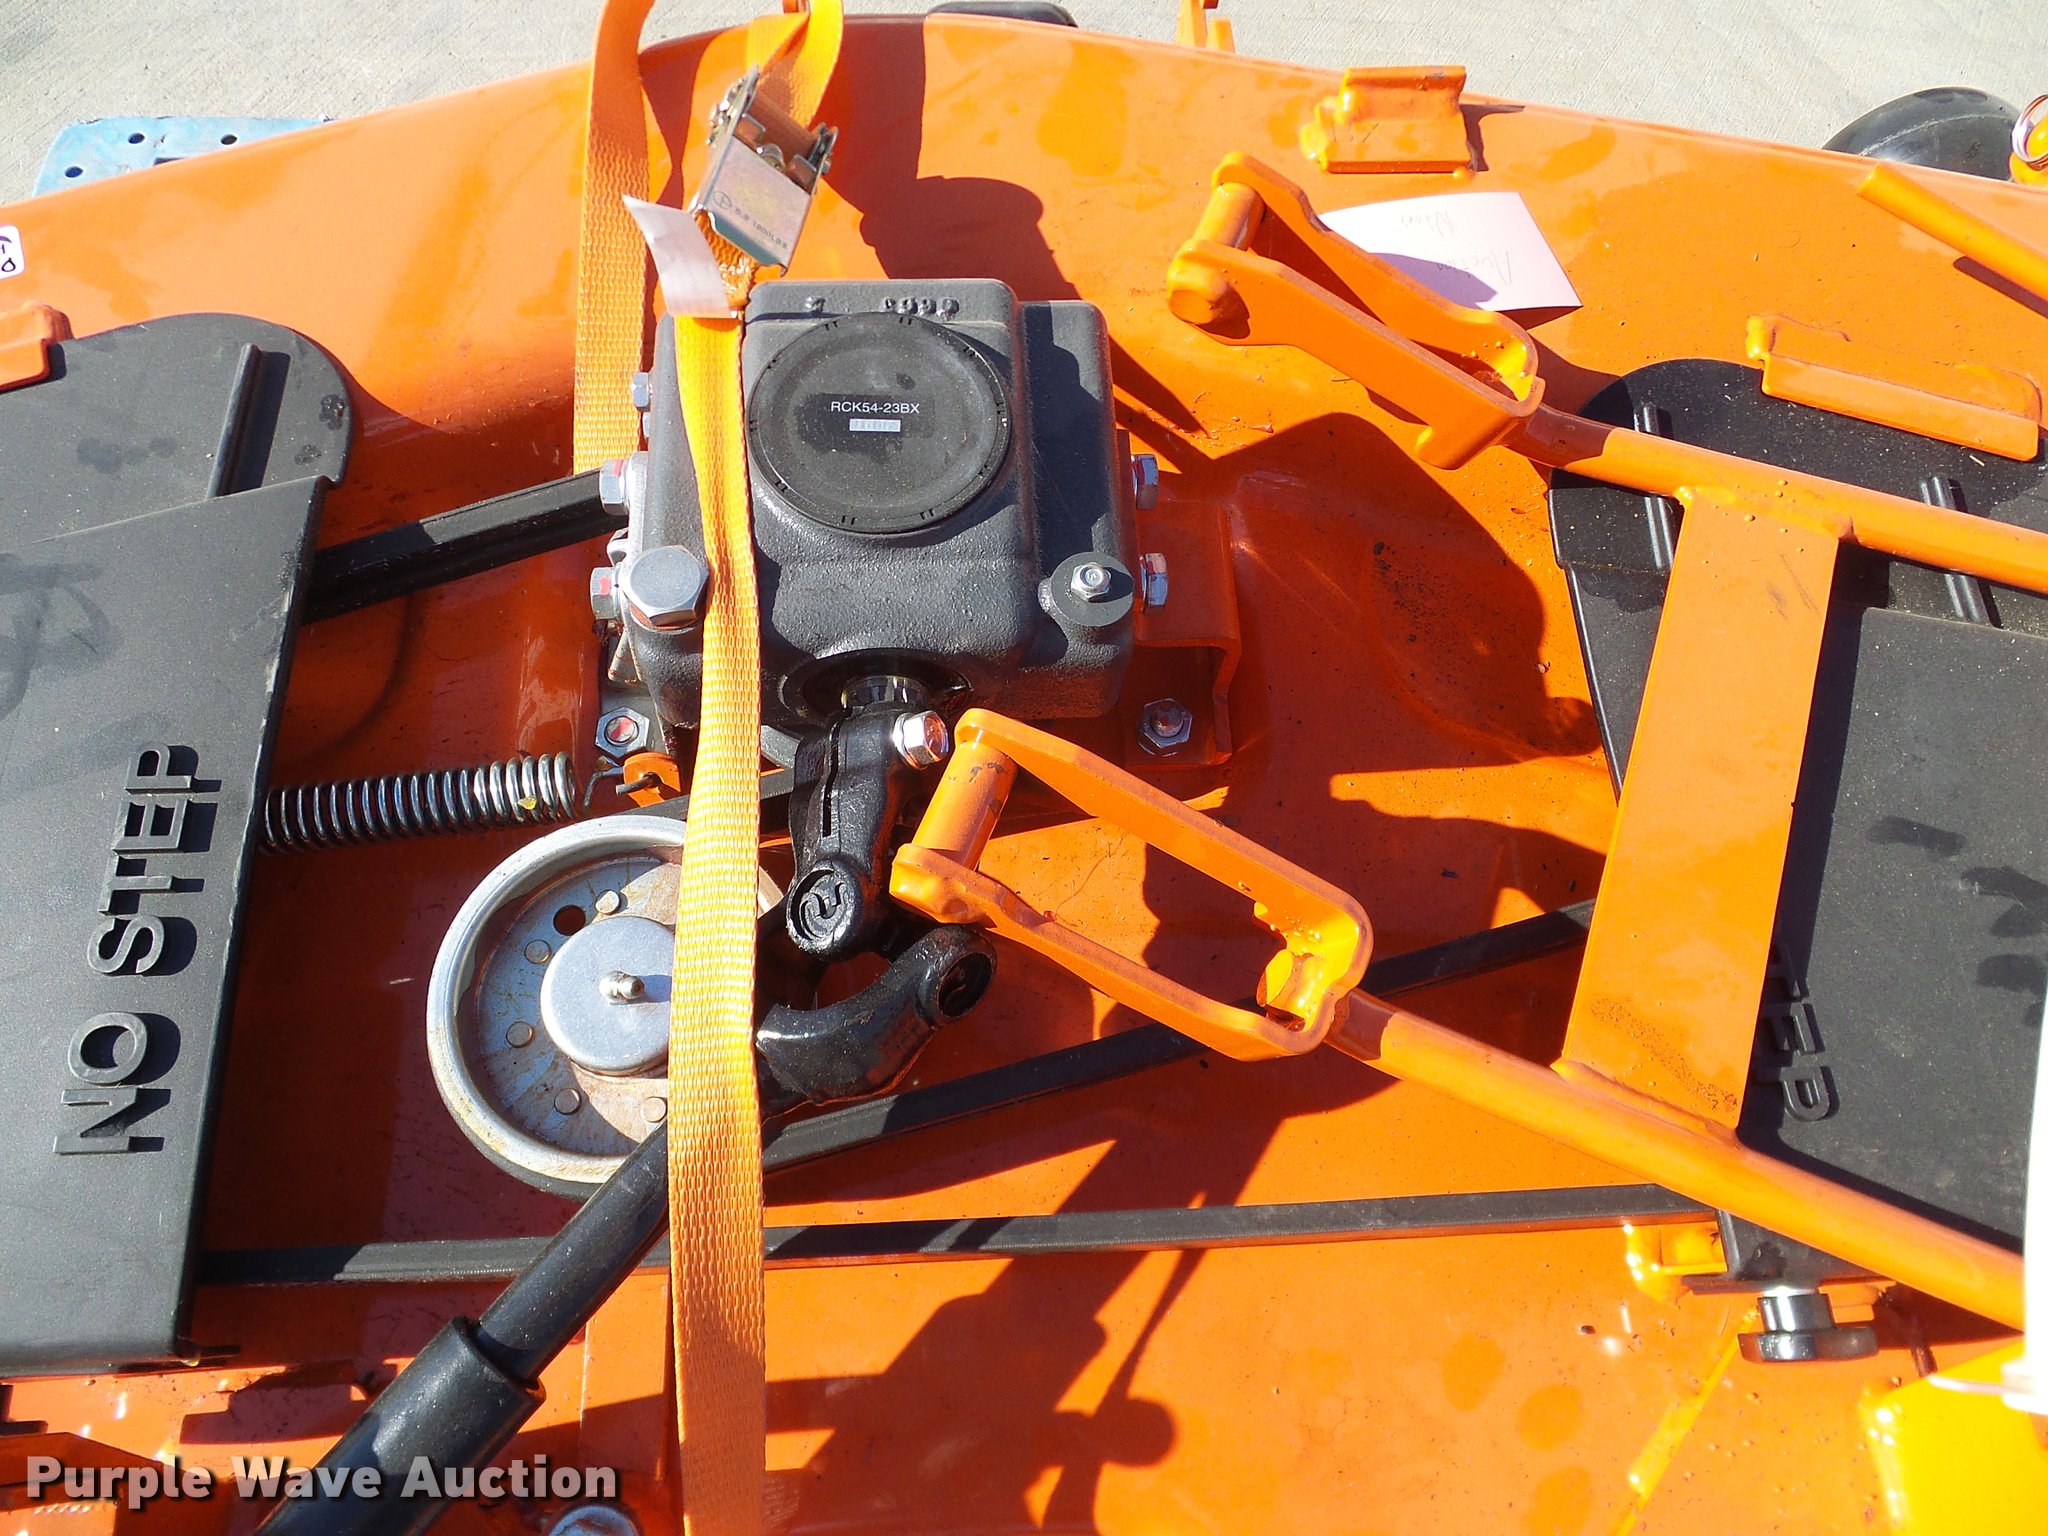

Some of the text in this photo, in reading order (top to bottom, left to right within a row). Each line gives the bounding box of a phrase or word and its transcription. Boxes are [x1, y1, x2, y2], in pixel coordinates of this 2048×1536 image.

[830, 401, 920, 415] RCK54-23BX
[53, 740, 194, 1155] NO STEP
